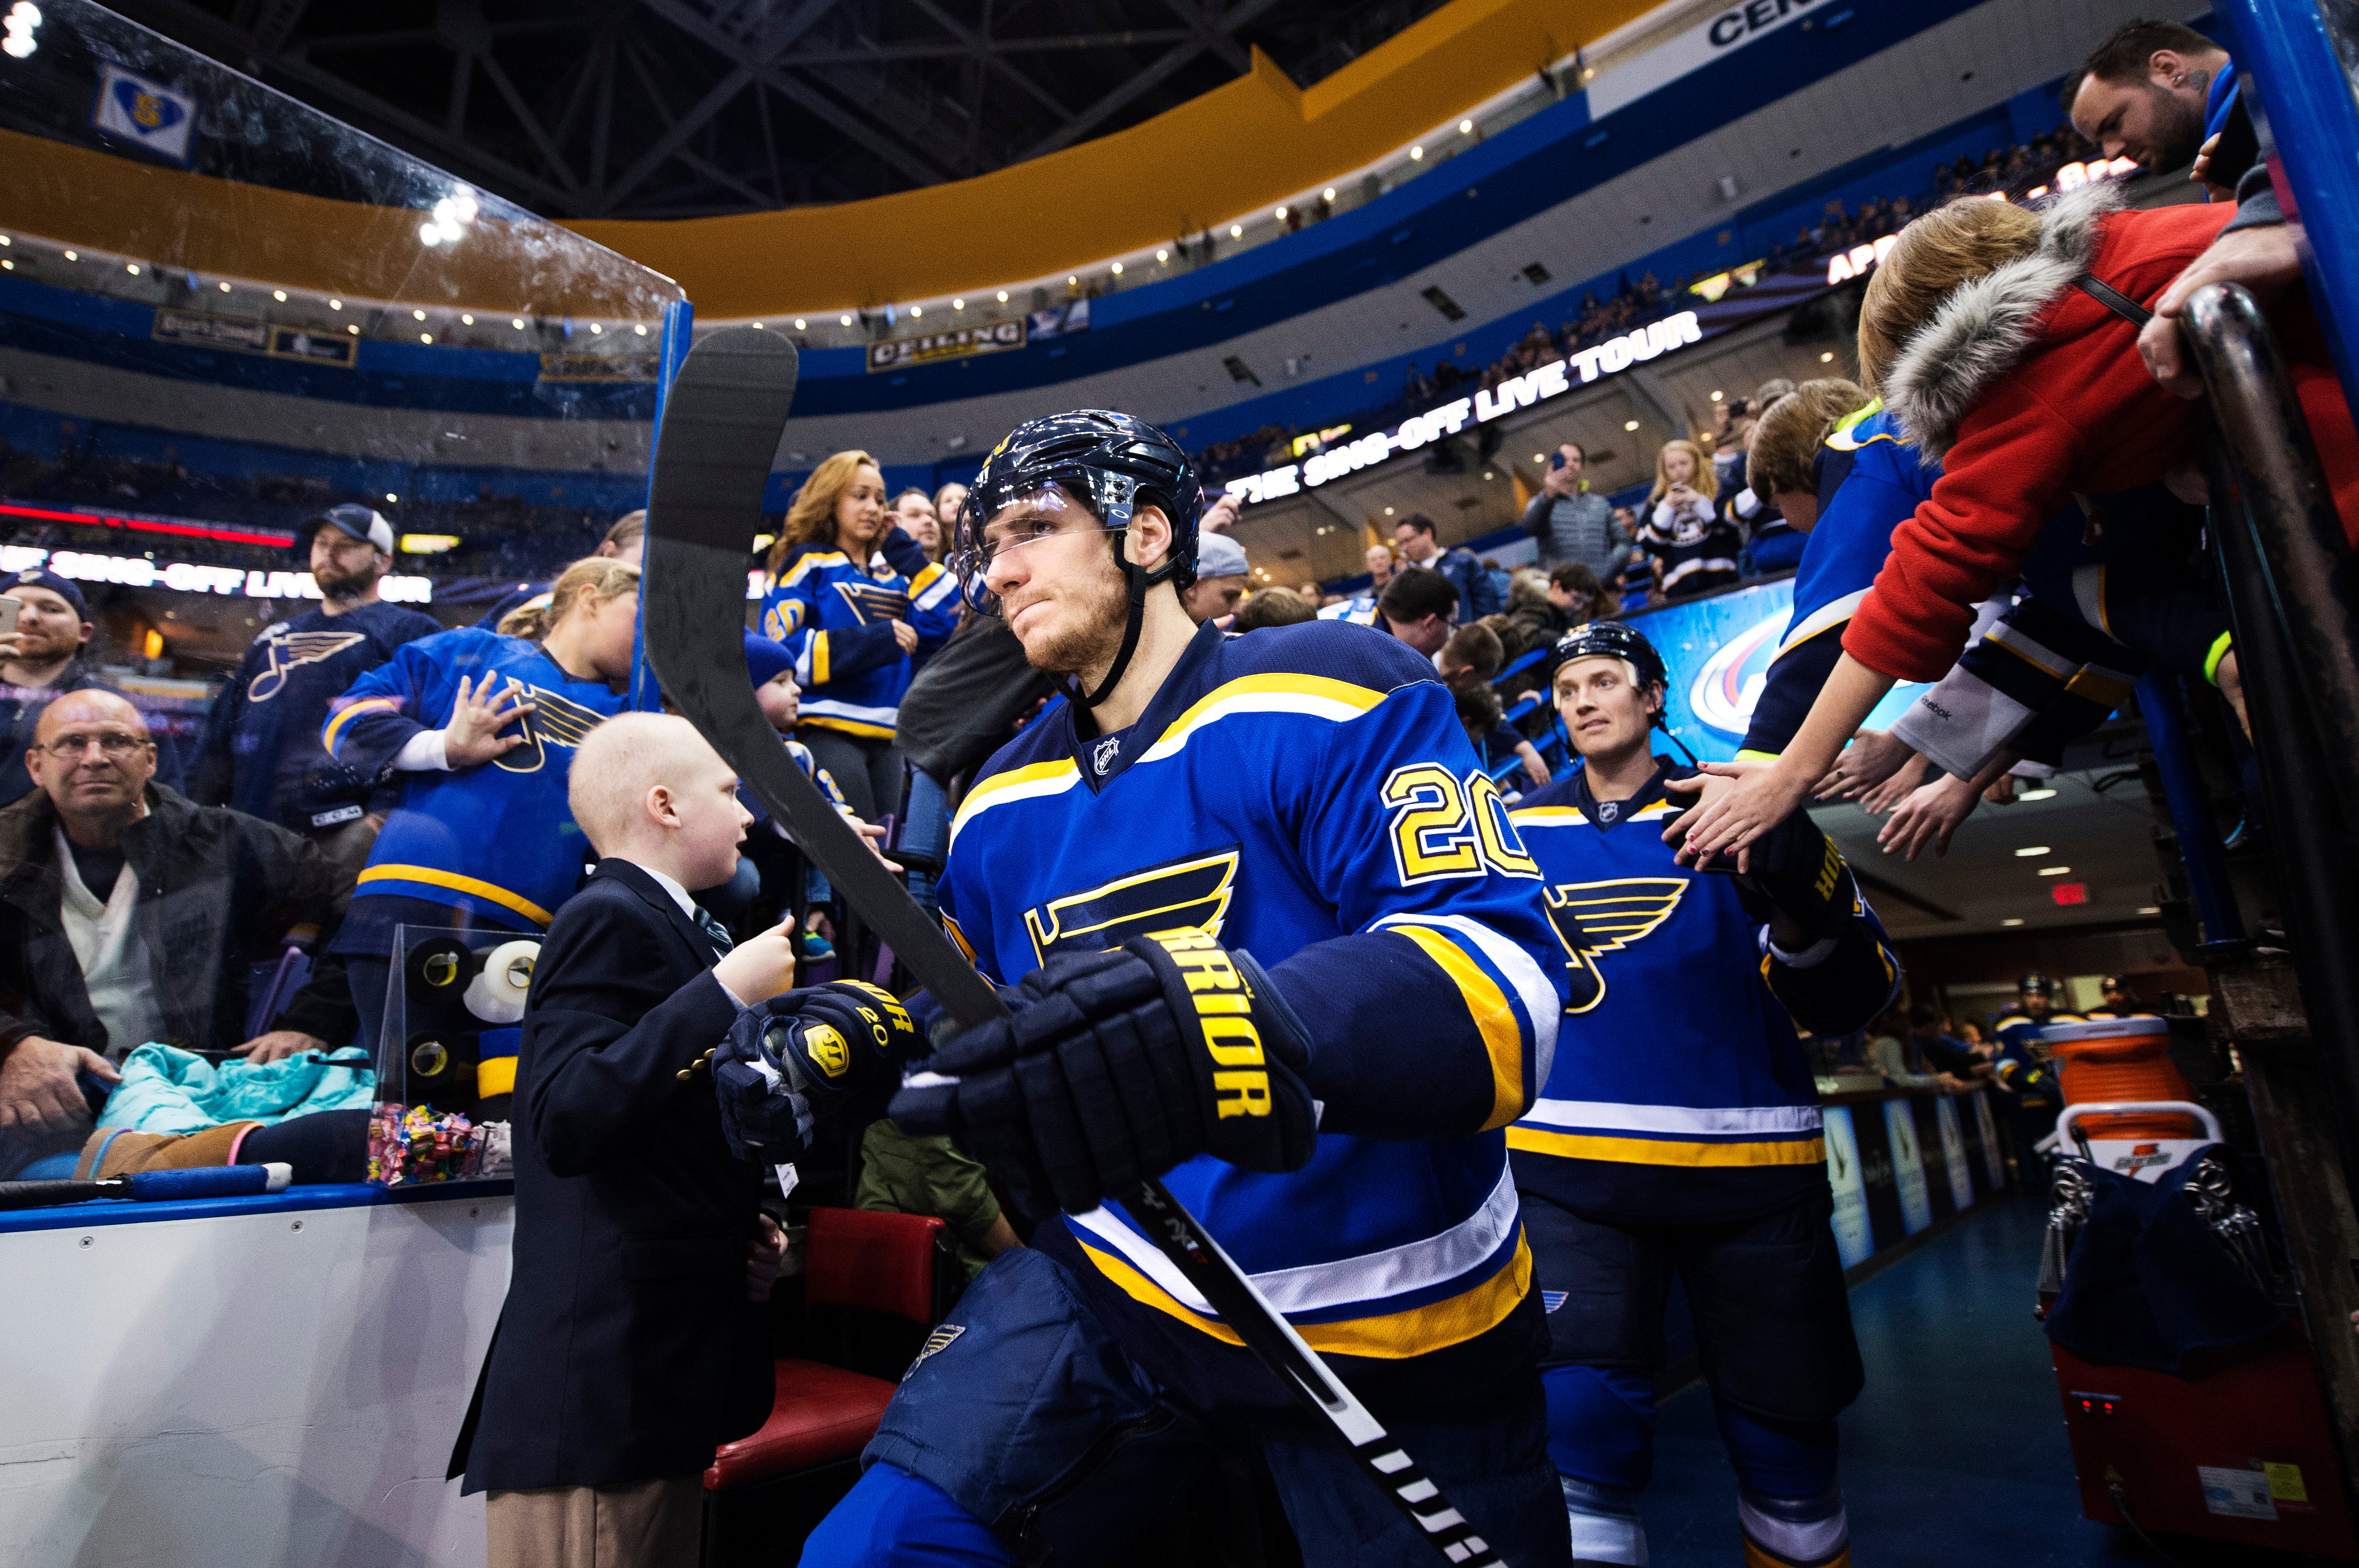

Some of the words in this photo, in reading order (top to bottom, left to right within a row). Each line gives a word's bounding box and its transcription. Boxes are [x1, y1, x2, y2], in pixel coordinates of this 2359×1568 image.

[874, 323, 1020, 365] CEILING
[1225, 464, 1300, 503] THE
[1304, 397, 1471, 486] SING-OFF
[1475, 359, 1569, 422] LIVE
[1569, 310, 1703, 383] TOUR
[377, 575, 432, 603] UR
[1099, 747, 1114, 770] NHL
[1379, 761, 1544, 887] 20
[855, 1007, 889, 1047] 20
[1143, 925, 1272, 1120] RRIOR
